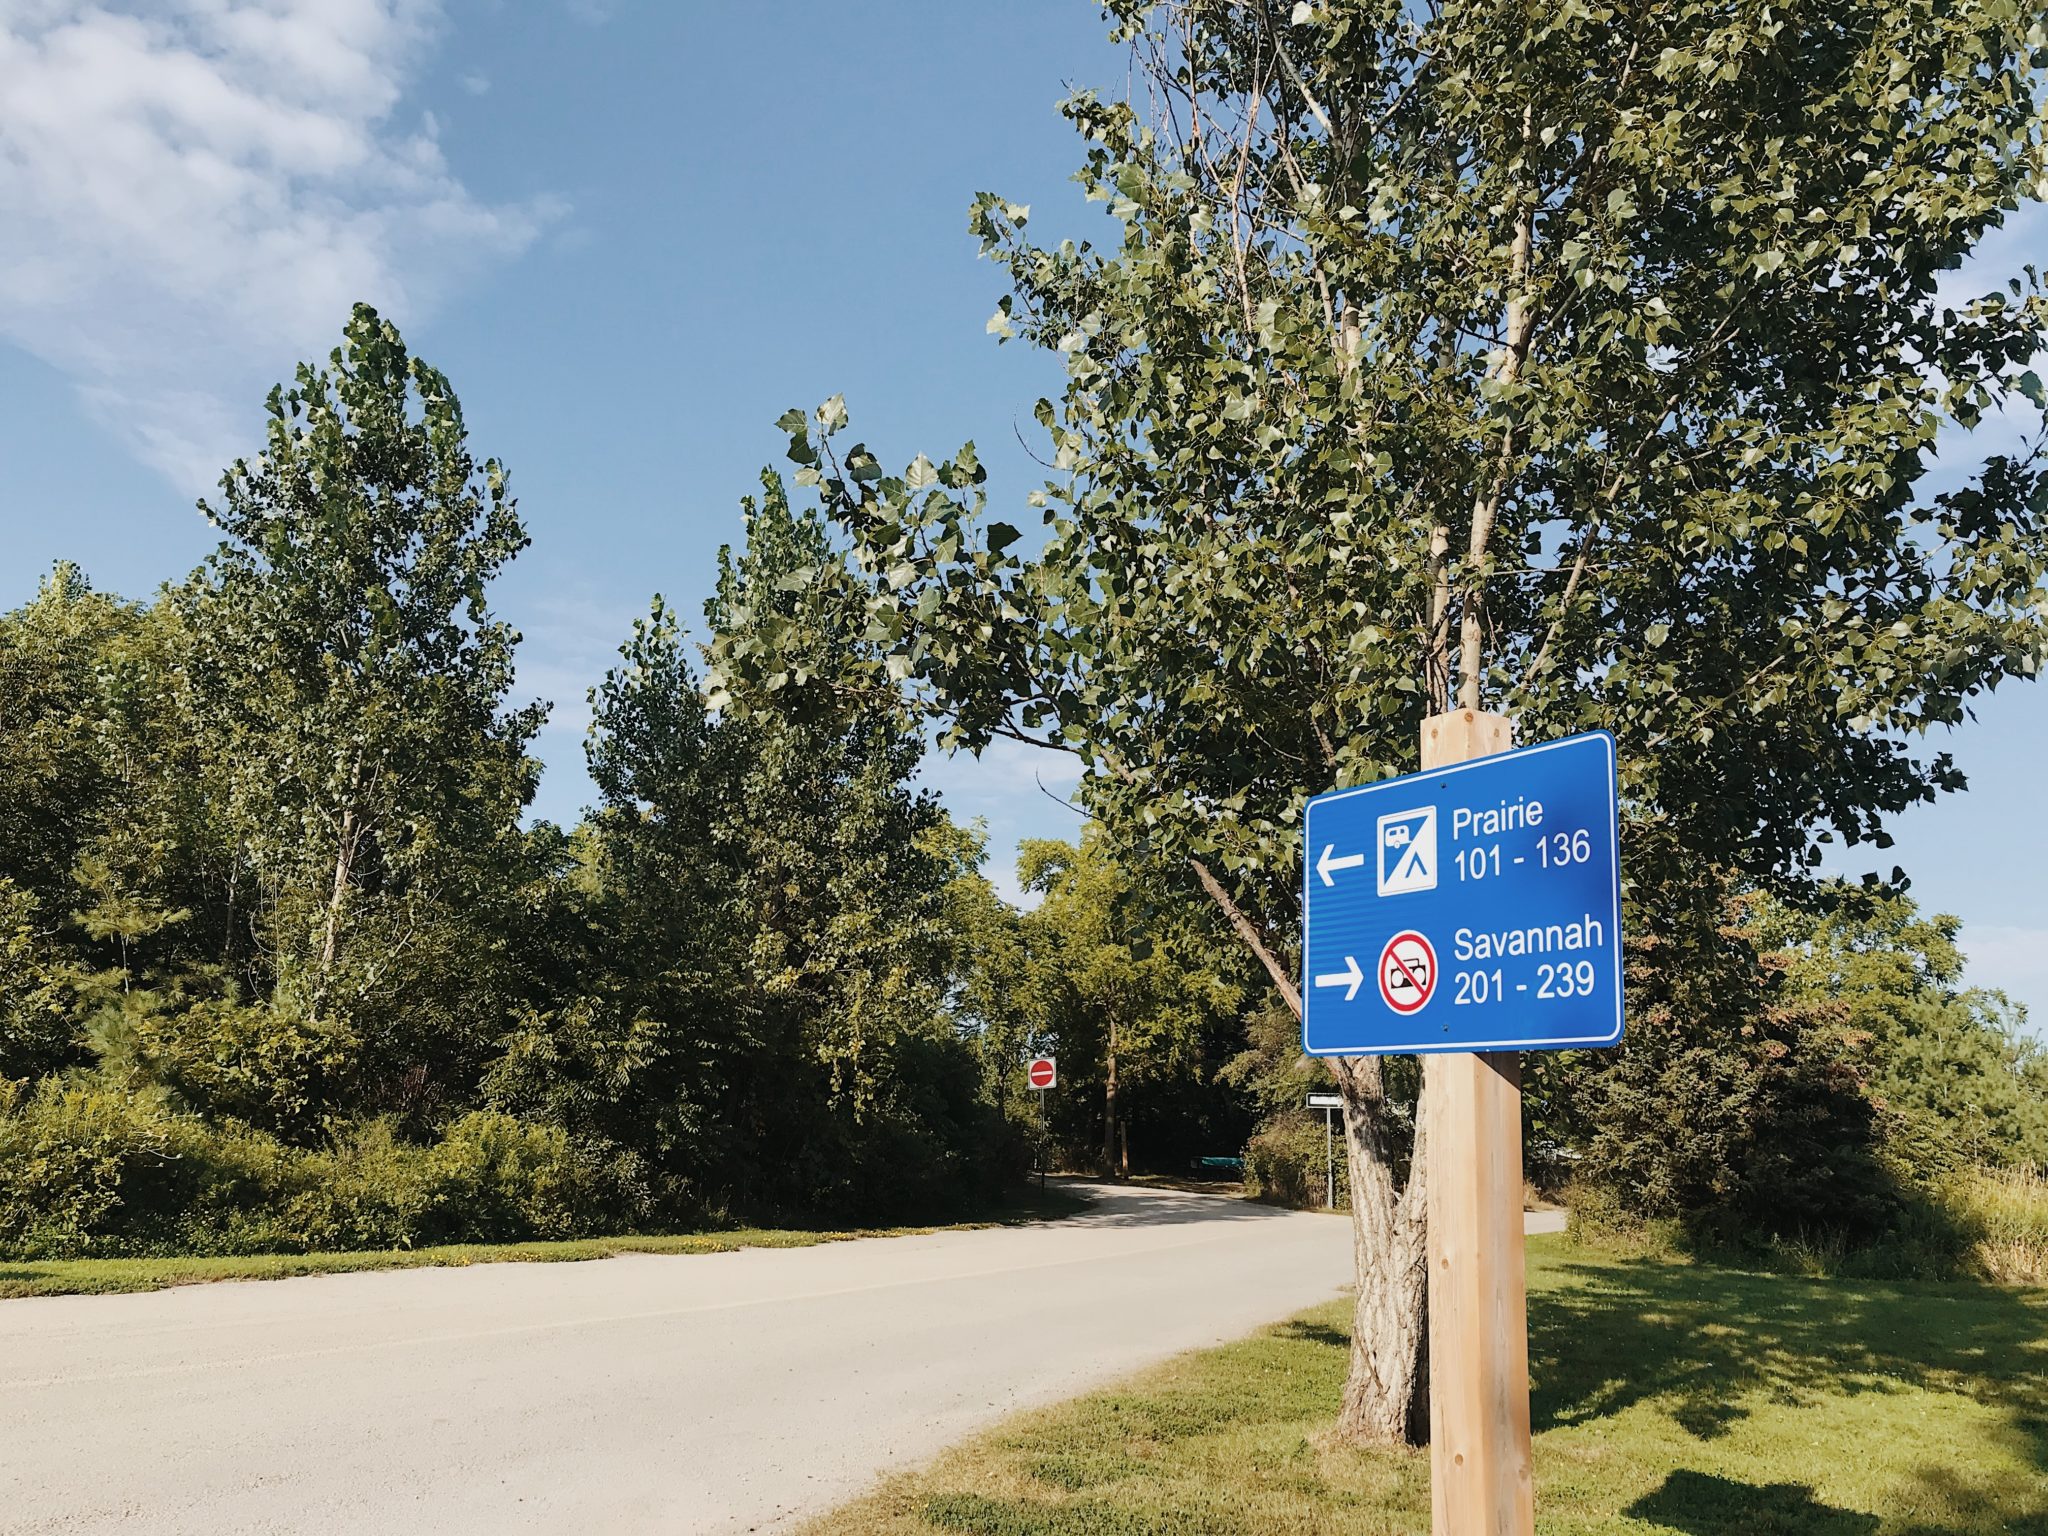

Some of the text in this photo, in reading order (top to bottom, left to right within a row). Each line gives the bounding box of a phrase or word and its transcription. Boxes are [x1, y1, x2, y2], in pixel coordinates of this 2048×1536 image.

[1453, 796, 1543, 840] Prairie
[1454, 829, 1591, 881] 101 - 136
[1454, 913, 1603, 961] Savannah
[1454, 960, 1595, 1005] 201 - 239
